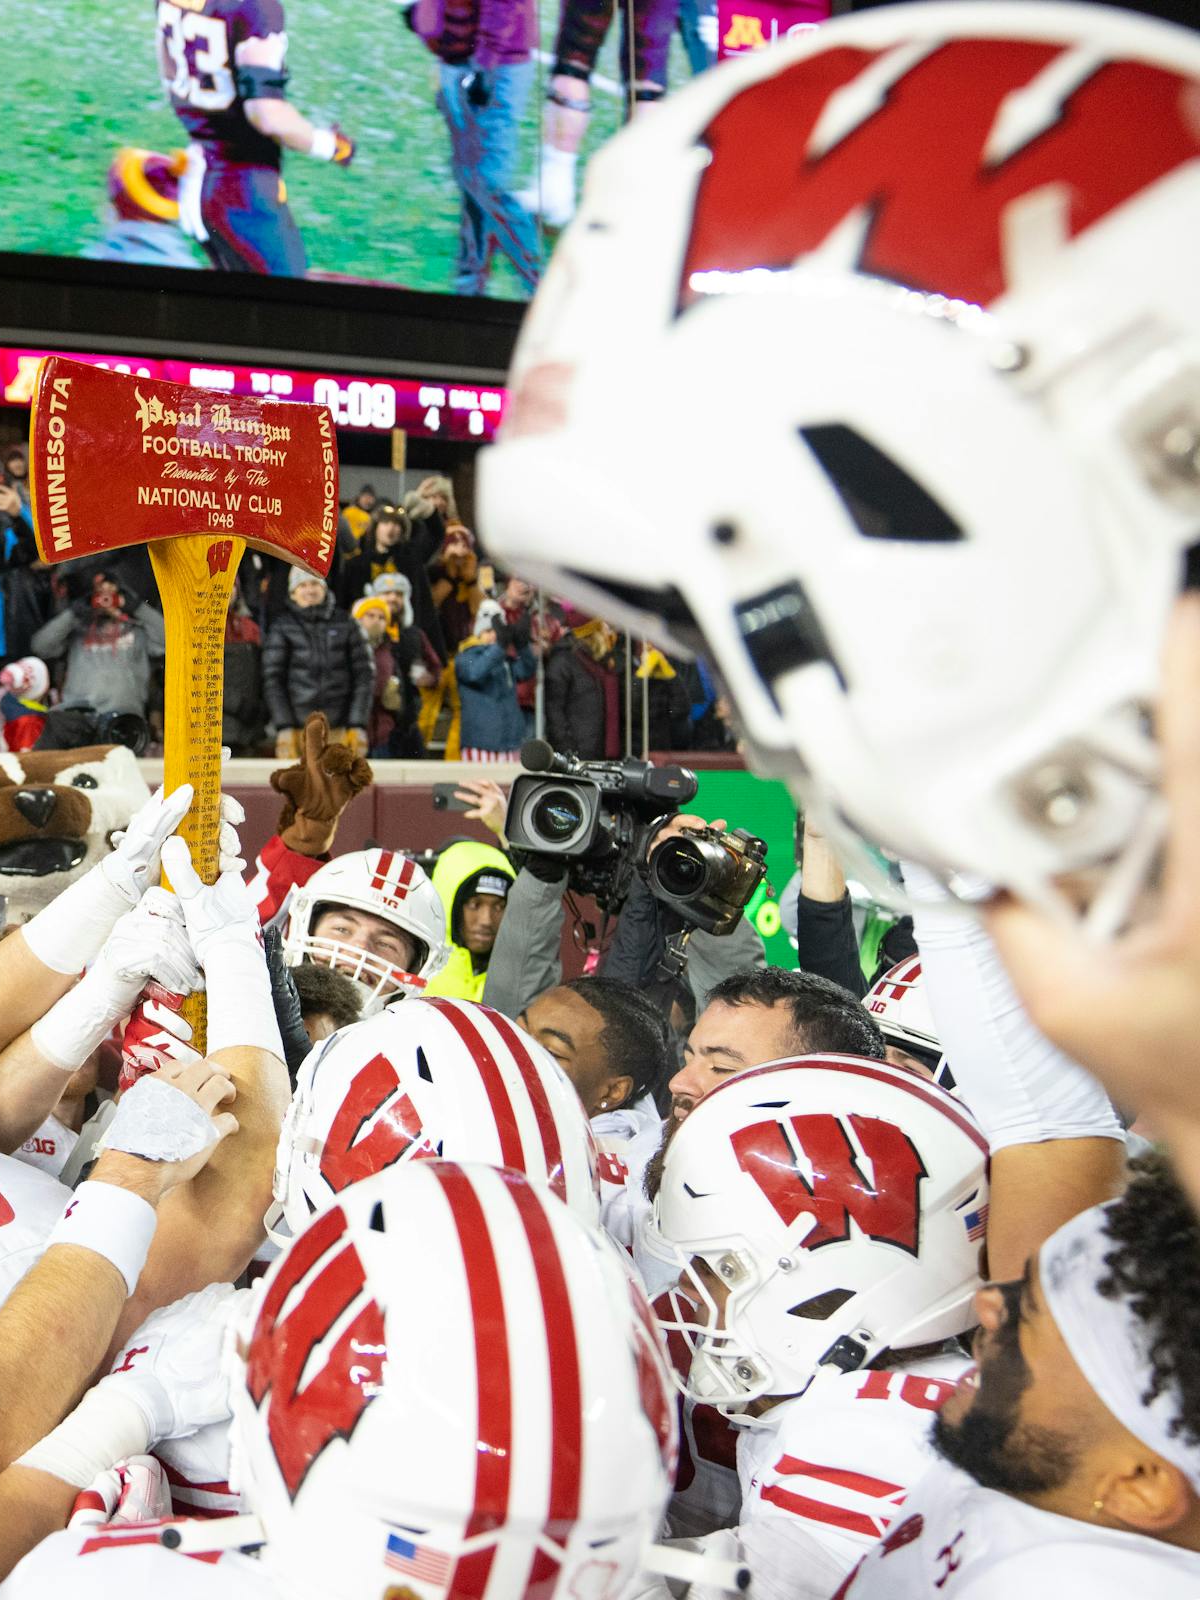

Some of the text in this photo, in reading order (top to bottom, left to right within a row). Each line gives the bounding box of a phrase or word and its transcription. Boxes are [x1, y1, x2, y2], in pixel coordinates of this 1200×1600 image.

[134, 386, 291, 446] Paul Bunyan
[314, 378, 396, 429] 0:09
[46, 378, 73, 552] MINNESOTA
[142, 435, 287, 467] FOOTBALL TROPHY
[160, 461, 270, 490] Presented by The
[317, 410, 335, 562] WISCONSIN
[138, 487, 282, 516] NATIONAL W CLUB
[208, 511, 234, 528] 1948
[206, 540, 233, 579] W
[729, 1112, 929, 1259] W
